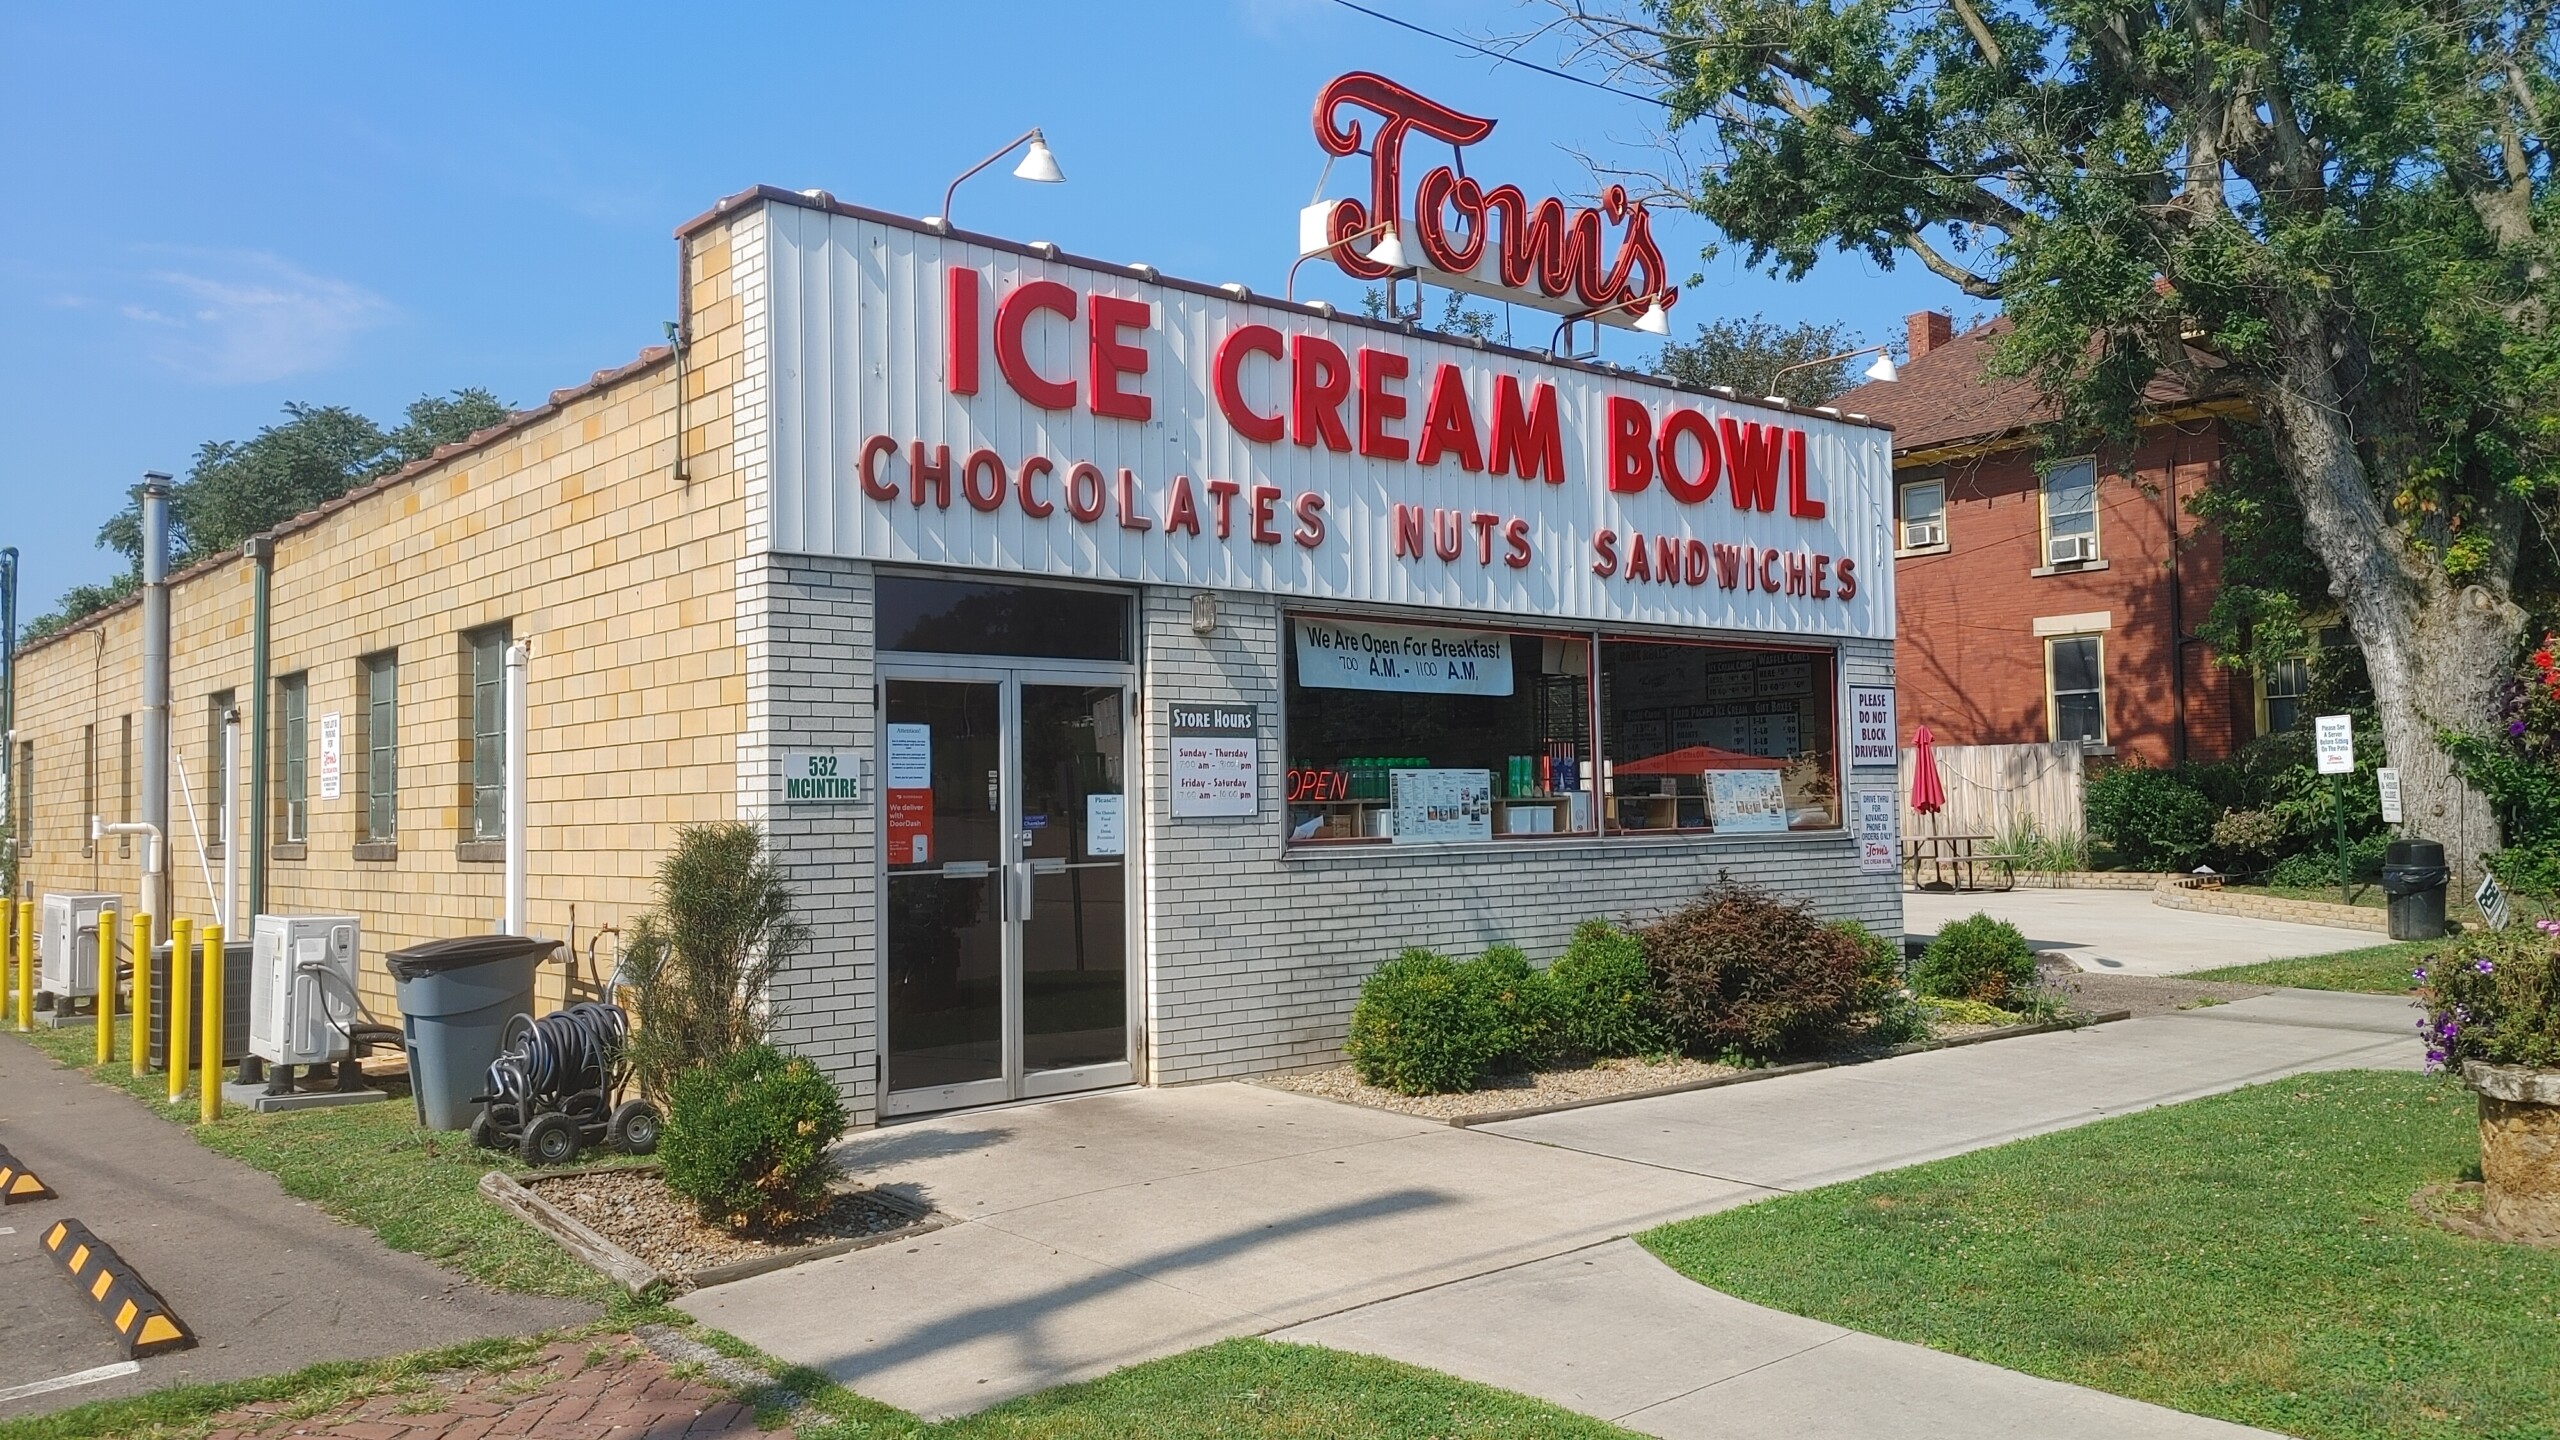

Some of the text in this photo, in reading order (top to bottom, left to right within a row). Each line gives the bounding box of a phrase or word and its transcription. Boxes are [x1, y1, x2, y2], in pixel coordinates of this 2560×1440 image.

[1312, 70, 1678, 317] Tom's
[948, 266, 1825, 520] ICE CREAM BOWL
[857, 434, 1856, 601] CHOCOLATES NUTS SANDWICHES
[1306, 627, 1500, 659] We Are Open For Breakfast
[1758, 654, 1785, 665] WAFFLE
[1370, 657, 1400, 678] A.M.
[1448, 661, 1478, 680] A.M.
[1859, 694, 1886, 706] PLEASE
[1716, 705, 1725, 716] ICE
[1727, 704, 1748, 715] CREAM
[1755, 701, 1792, 712] GIFT BOXES
[1174, 709, 1251, 728] STORE HOURS
[1859, 711, 1887, 723] DO NOT
[1862, 728, 1886, 740] BLOCK
[1179, 748, 1206, 758] Sunday
[1215, 748, 1248, 758] Thursday
[1855, 745, 1894, 758] DRIVEWAY
[809, 756, 837, 776] 532
[788, 778, 857, 799] MCINTIRE
[1181, 778, 1205, 788] Friday
[1214, 778, 1247, 788] Saturday
[1287, 770, 1348, 800] OPEN
[1240, 792, 1251, 800] pm
[1863, 795, 1889, 803] DRIVE THRU
[1882, 823, 1886, 831] IN
[1862, 833, 1879, 841] ORDERS
[1865, 842, 1889, 858] Tom's
